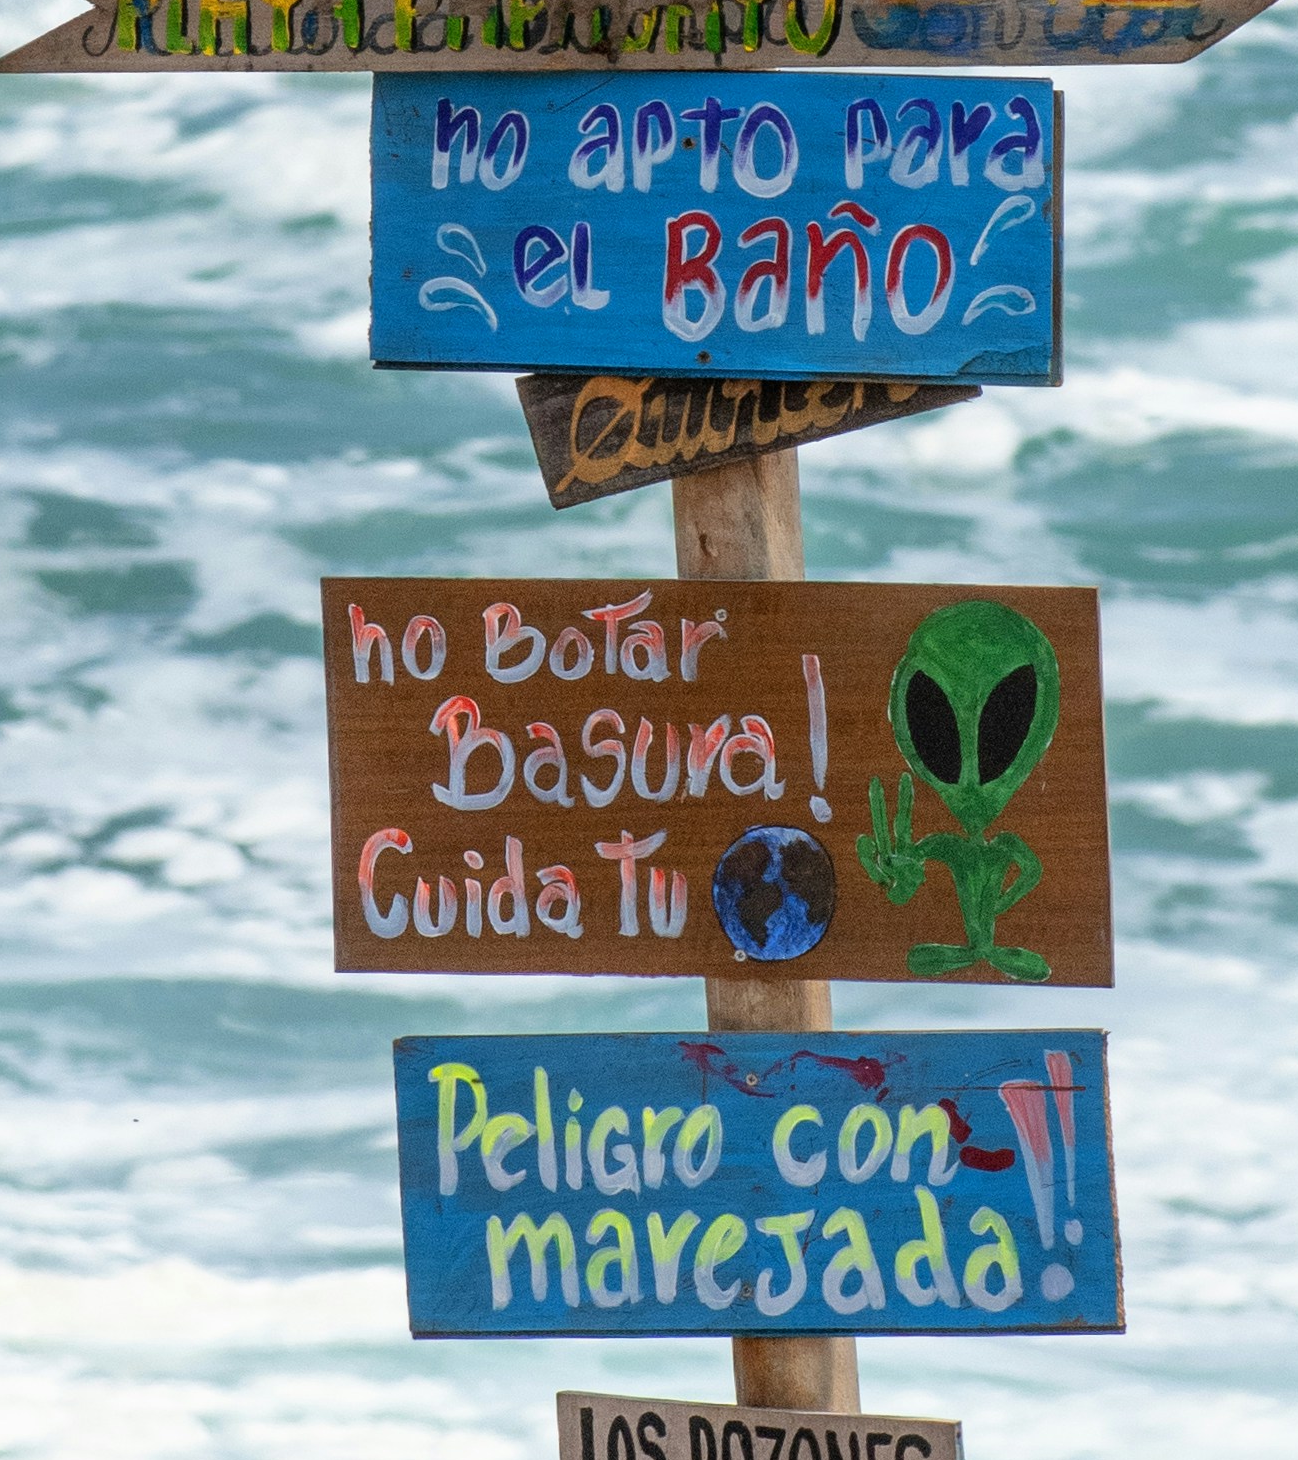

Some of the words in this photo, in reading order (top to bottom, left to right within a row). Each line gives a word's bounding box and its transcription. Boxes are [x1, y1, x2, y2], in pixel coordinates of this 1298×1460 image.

[430, 96, 530, 192] no
[843, 94, 1046, 190] para
[512, 220, 610, 310] el
[660, 200, 956, 342] Baño
[348, 602, 447, 686] no
[429, 654, 834, 824] Basura!
[358, 827, 583, 940] Cuida
[594, 829, 689, 939] Tu
[428, 1062, 725, 1201] Peligro
[771, 1103, 961, 1187] con
